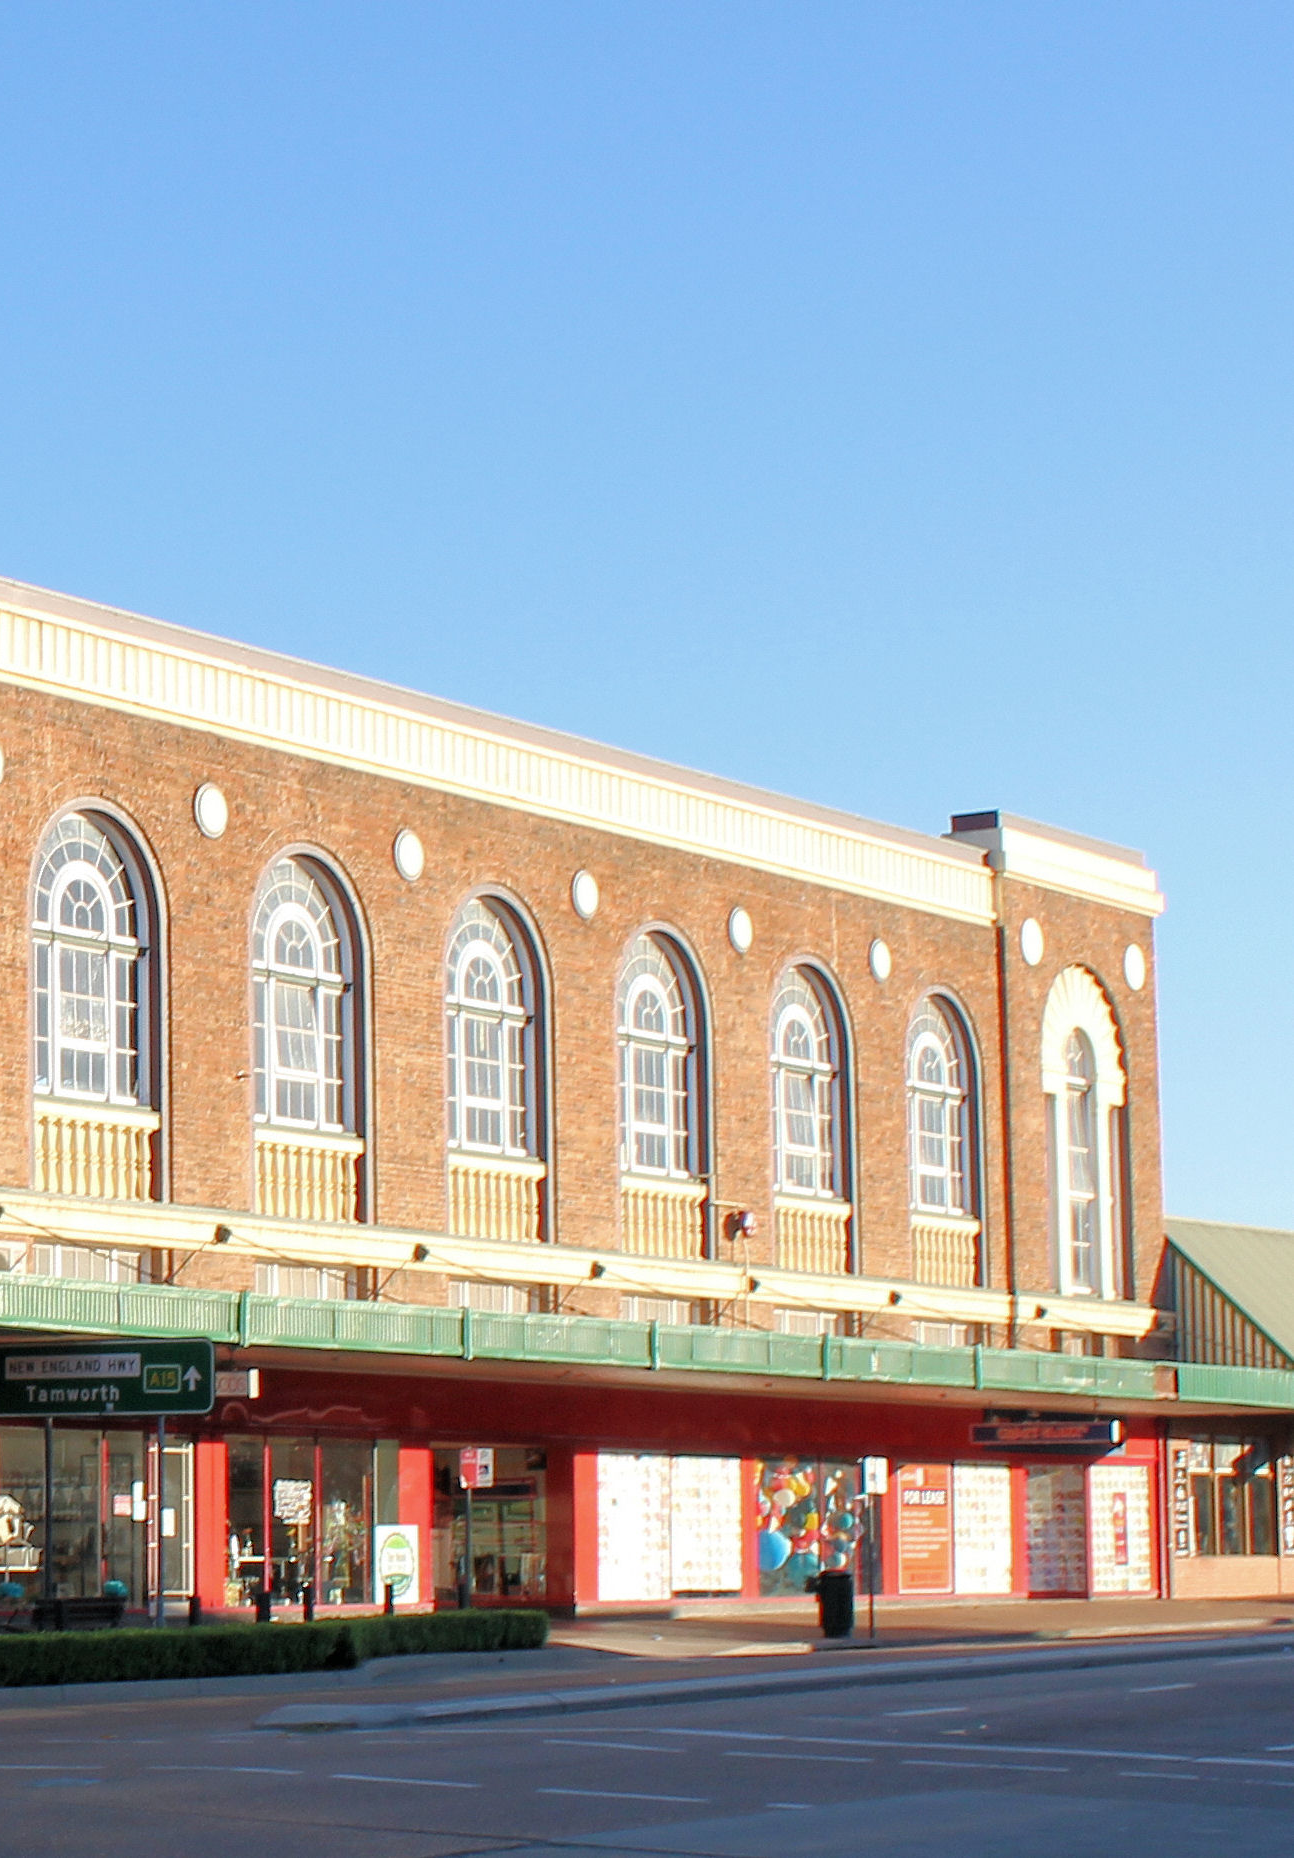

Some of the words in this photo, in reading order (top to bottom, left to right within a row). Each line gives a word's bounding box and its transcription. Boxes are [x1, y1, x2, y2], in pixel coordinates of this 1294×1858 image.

[9, 1360, 35, 1374] NEW
[41, 1359, 101, 1373] ENGLAND
[107, 1358, 135, 1371] HWY
[149, 1371, 176, 1388] A15
[26, 1384, 120, 1402] Tamworth
[903, 1490, 917, 1504] FOR
[921, 1490, 946, 1505] LEASE
